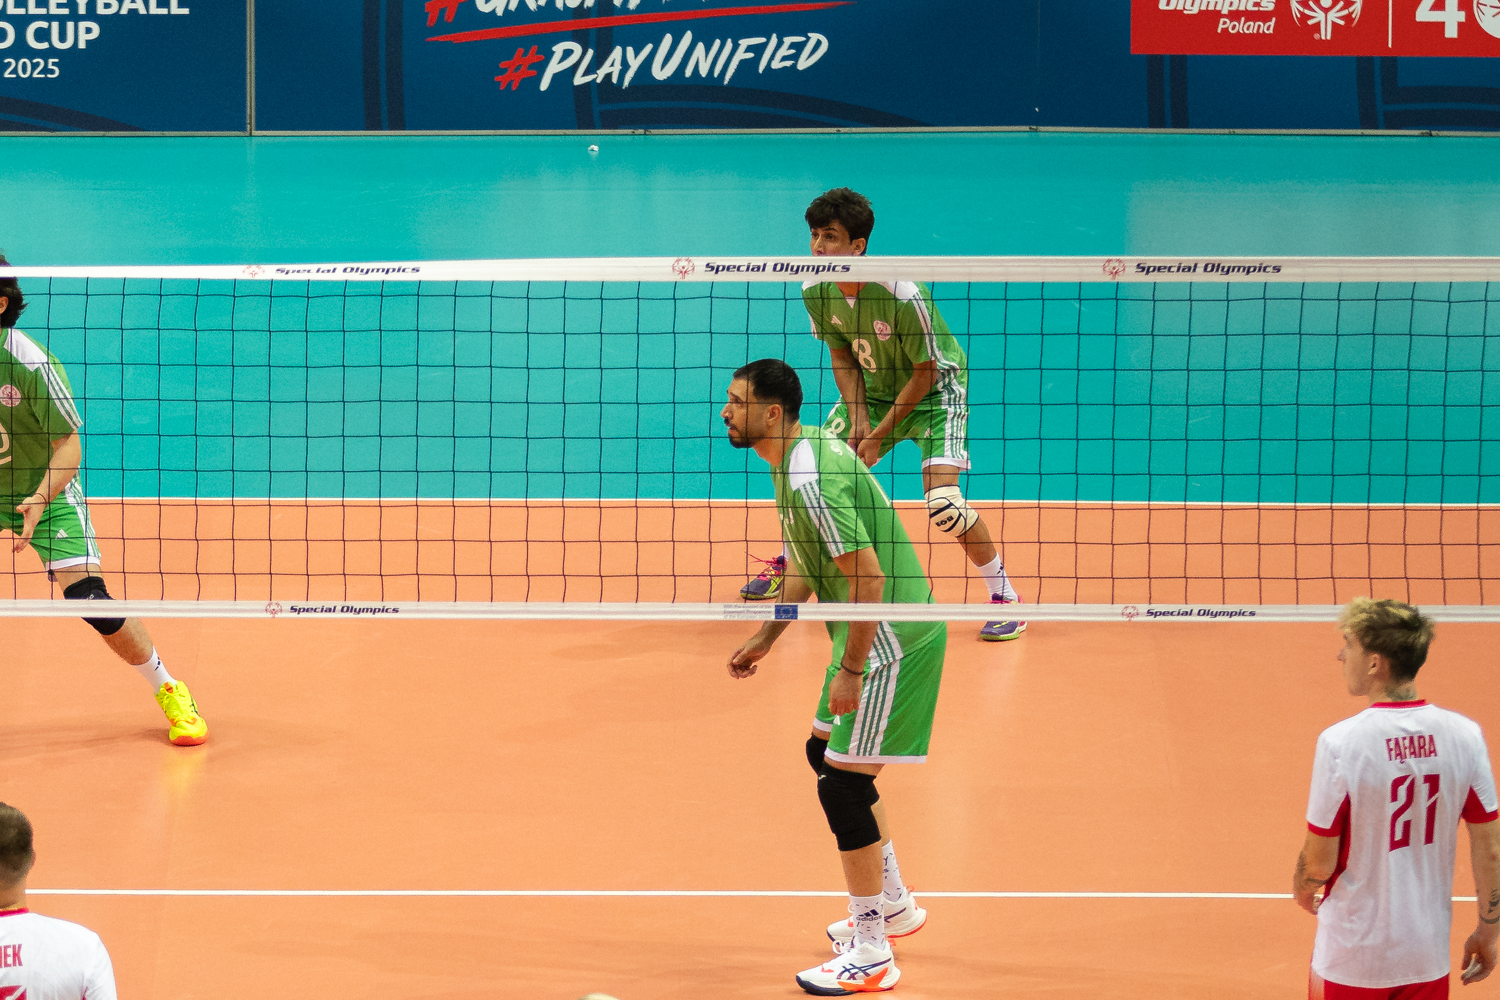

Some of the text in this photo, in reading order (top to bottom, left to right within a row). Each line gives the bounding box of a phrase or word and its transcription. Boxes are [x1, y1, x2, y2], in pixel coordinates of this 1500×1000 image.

[1217, 17, 1276, 34] Poland
[25, 21, 101, 50] CUP
[3, 58, 60, 78] 2025
[704, 262, 851, 276] Special Olympics
[1135, 262, 1282, 276] Special Olympics
[851, 338, 877, 374] 8
[289, 604, 400, 615] Special Olympics
[1145, 608, 1257, 619] Special Olympics
[1388, 773, 1440, 852] 21
